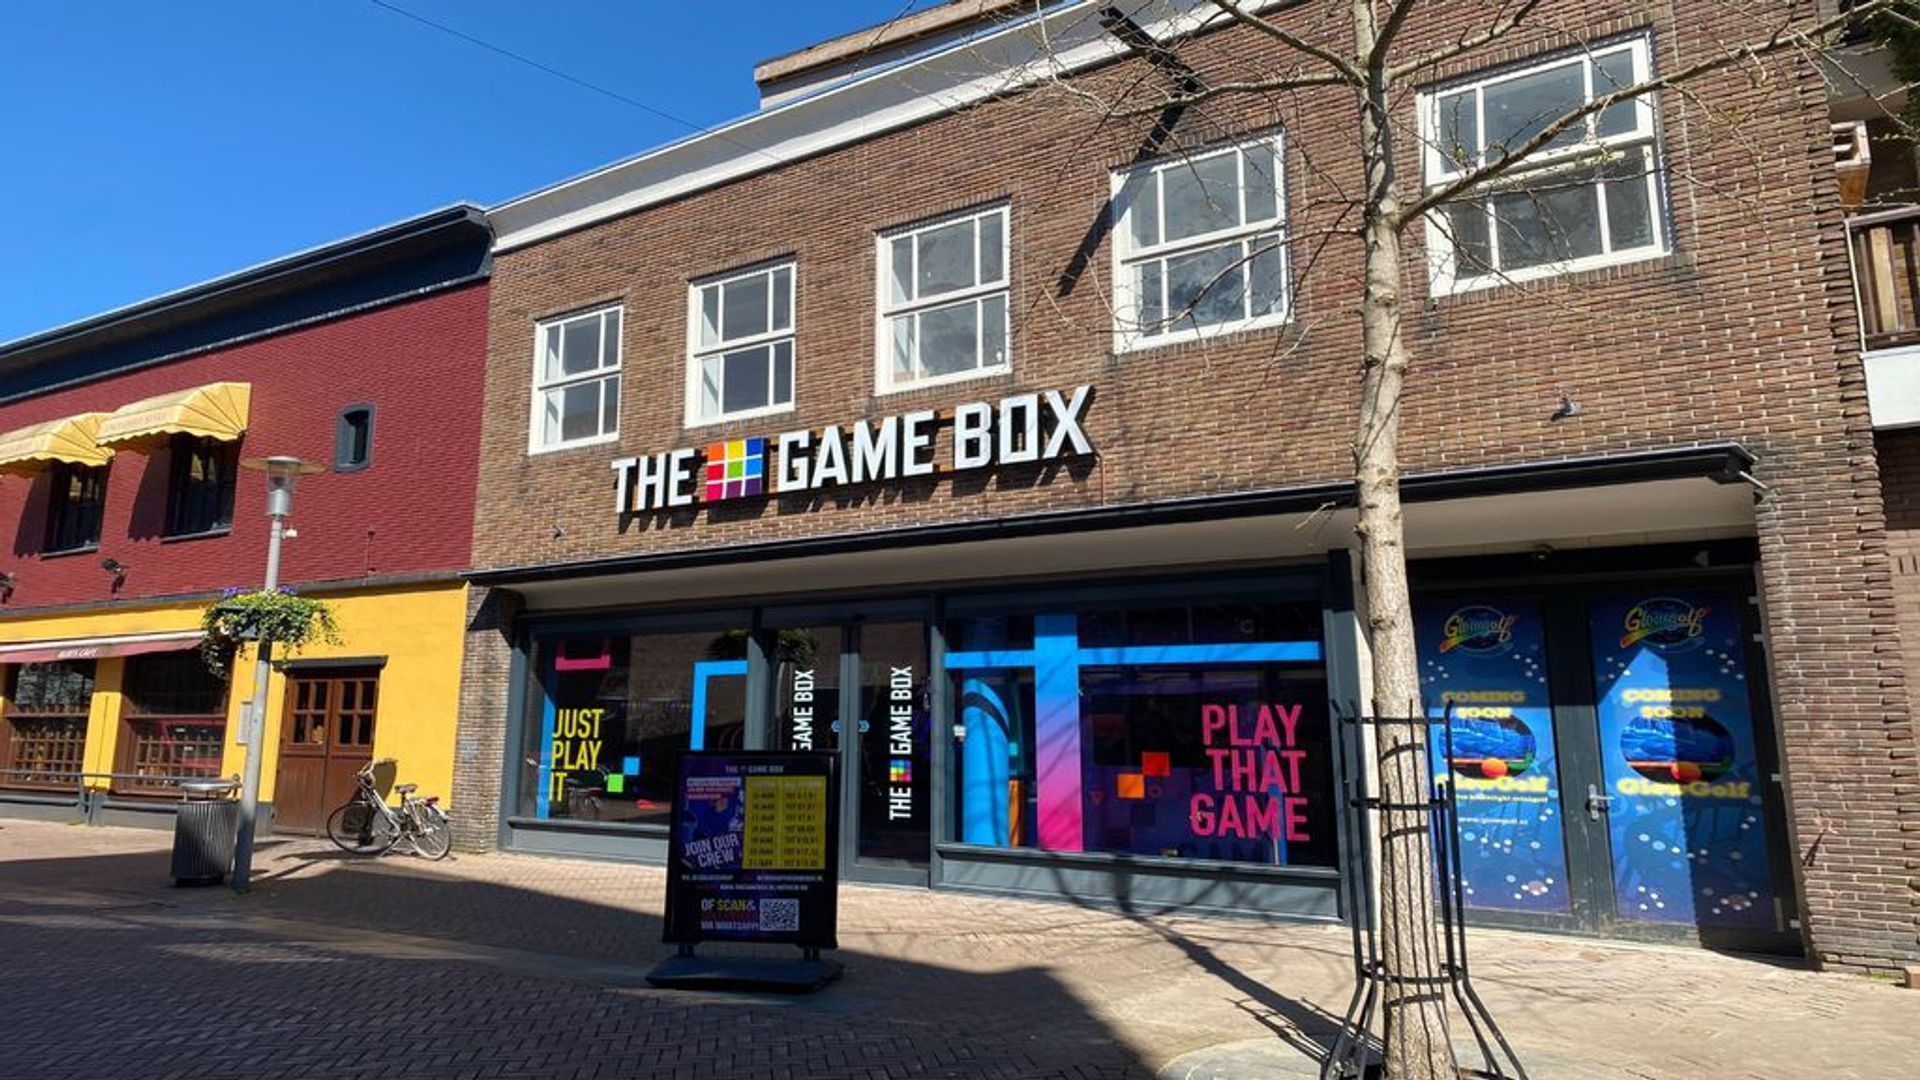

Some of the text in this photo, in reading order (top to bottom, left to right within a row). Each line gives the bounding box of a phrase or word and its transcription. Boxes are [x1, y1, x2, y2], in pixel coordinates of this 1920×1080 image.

[611, 385, 1094, 513] THE GAME BOX
[792, 669, 815, 751] GAME BOX
[1442, 690, 1526, 703] COMING
[1622, 688, 1722, 702] COMING
[552, 708, 604, 739] JUST
[1202, 704, 1303, 747] PLAY
[1456, 706, 1512, 719] SOON
[1641, 704, 1706, 719] SOON
[551, 740, 602, 770] PLAY
[889, 666, 912, 821] THE GAME BOX
[1205, 749, 1306, 793] THAT
[549, 772, 567, 802] IT
[1190, 793, 1311, 841] GAME
[684, 838, 712, 857] JOIN
[713, 832, 738, 851] OUR
[697, 847, 736, 870] CREW
[701, 898, 715, 911] OF
[717, 898, 746, 911] SCAN
